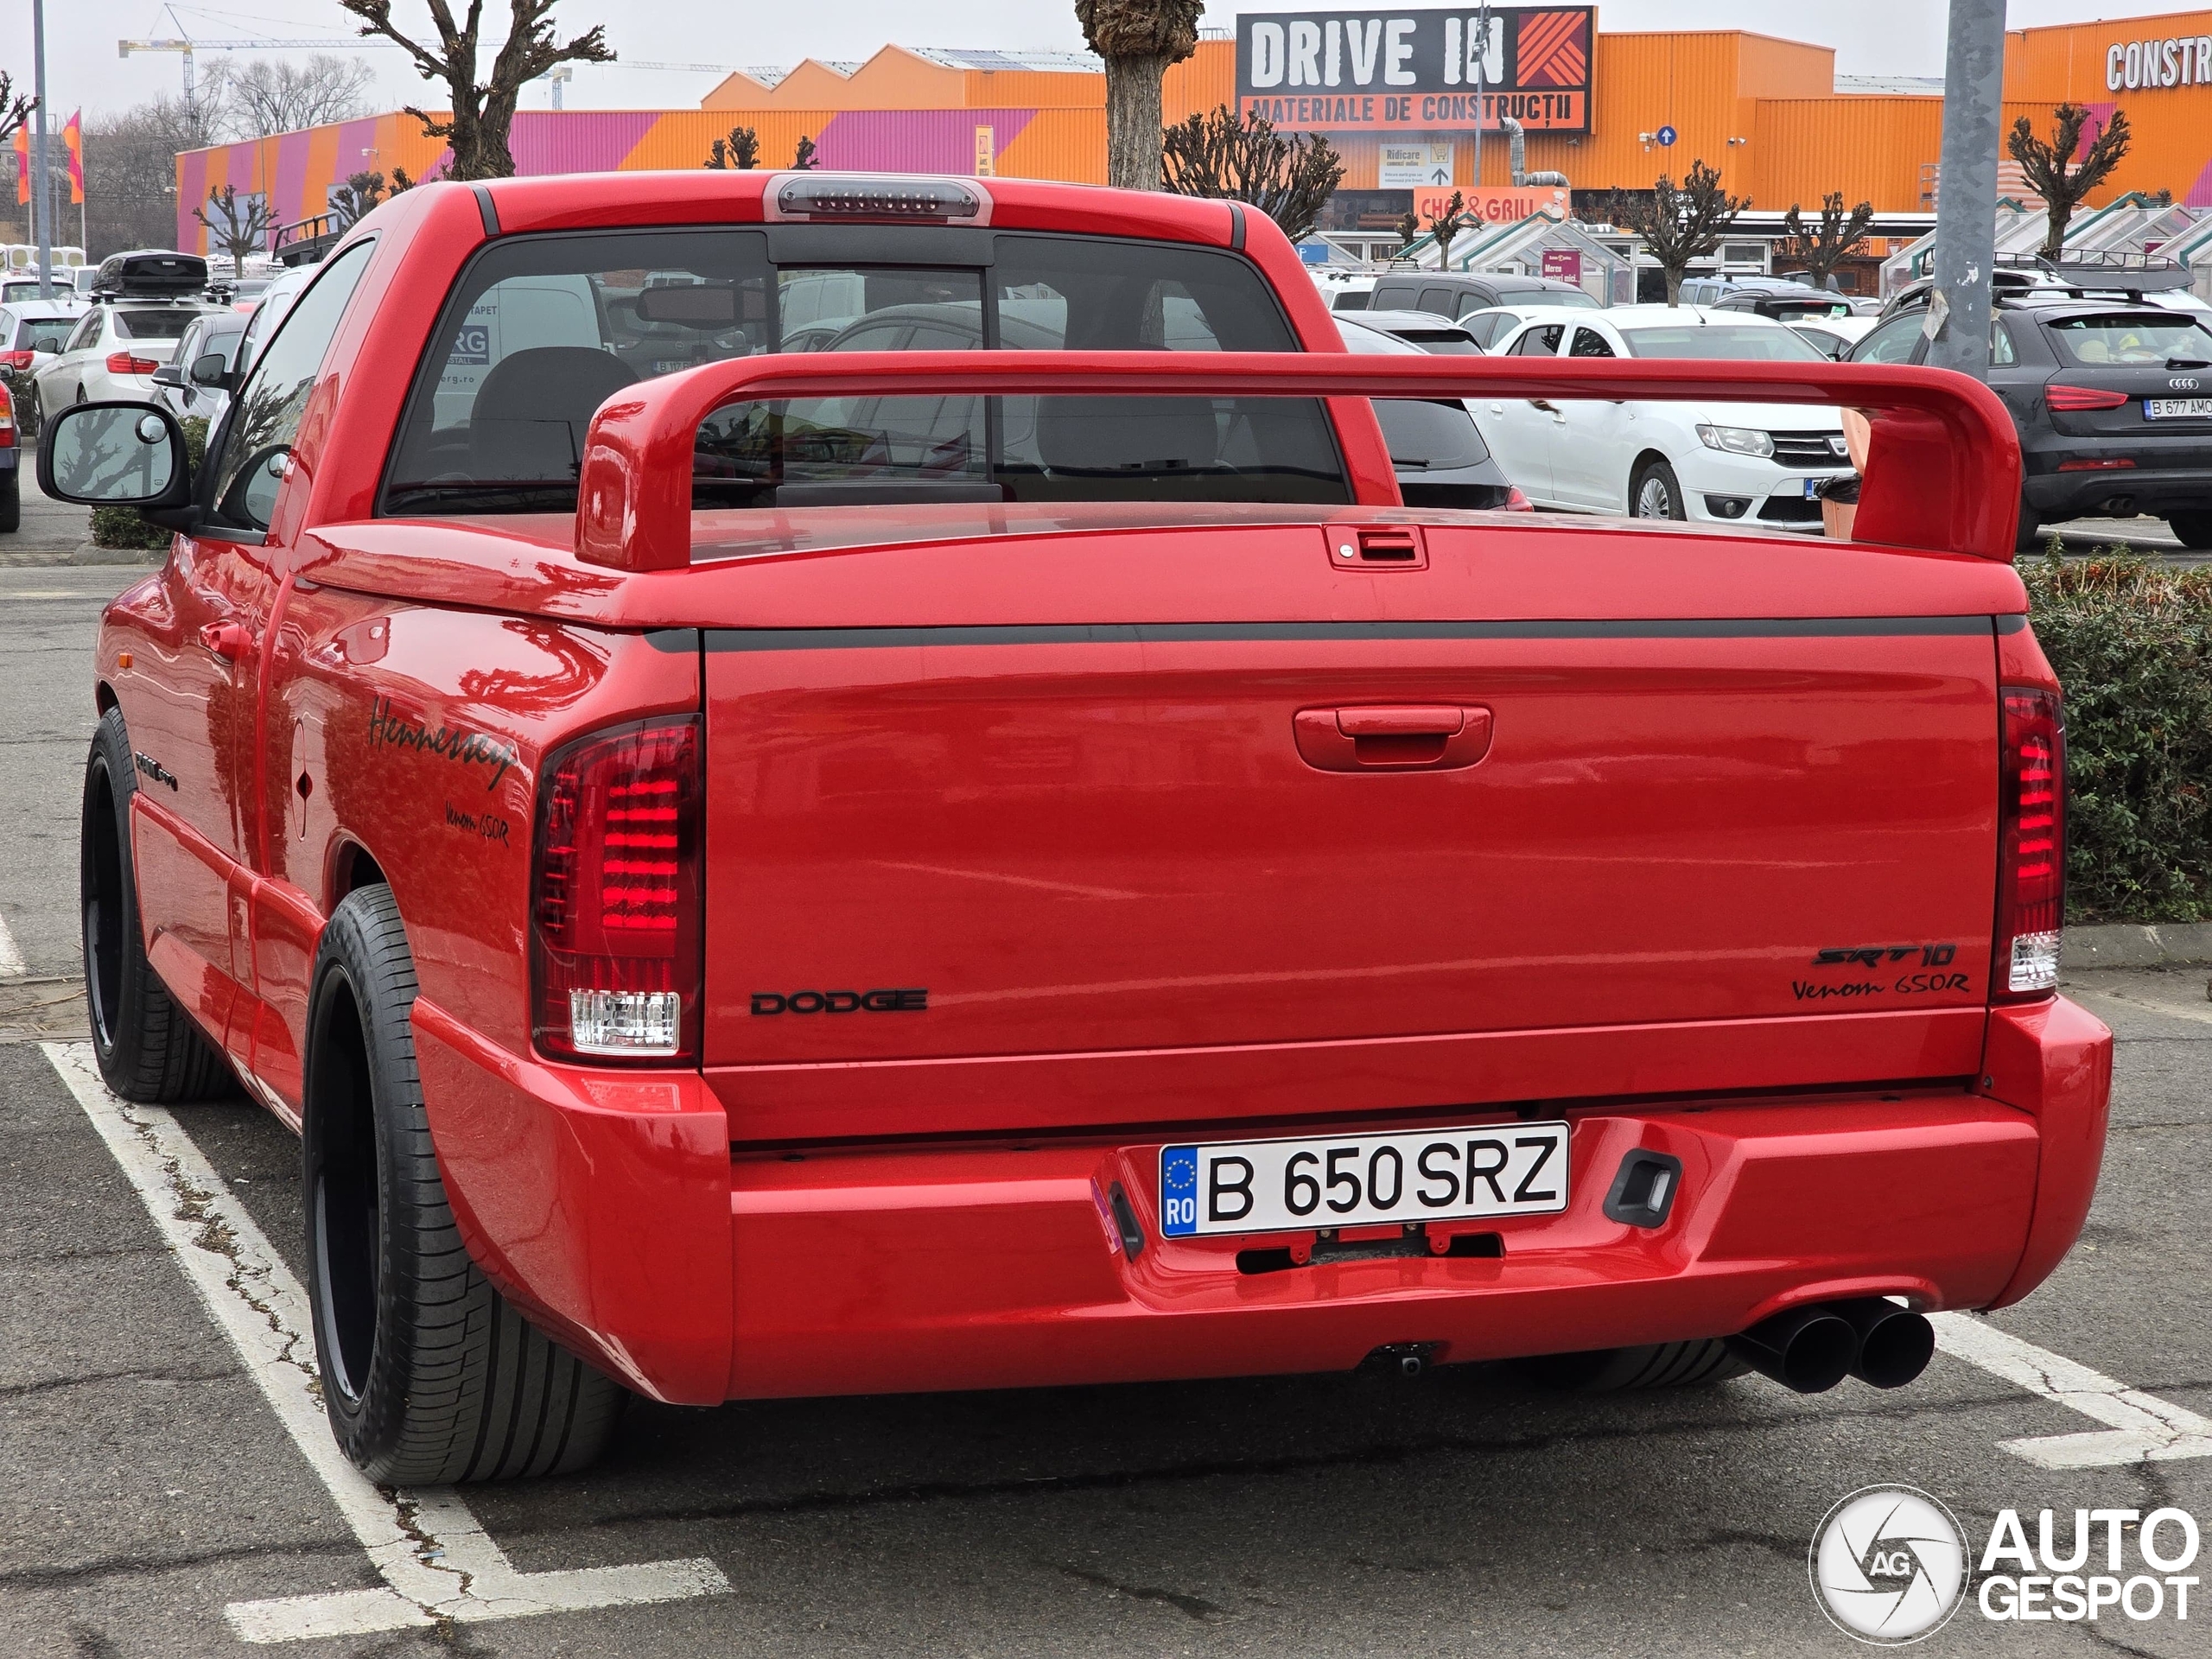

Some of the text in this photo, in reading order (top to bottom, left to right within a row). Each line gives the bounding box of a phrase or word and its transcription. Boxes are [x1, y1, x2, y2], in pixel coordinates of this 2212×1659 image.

[1251, 16, 1504, 87] DRIVE IN
[2107, 35, 2212, 92] CONSTR
[1253, 97, 1375, 123] MATERIALE
[1384, 96, 1411, 122] DE
[1386, 149, 1421, 160] Ridicare
[1467, 195, 1484, 221] &
[1485, 198, 1534, 221] GRILL
[2152, 401, 2161, 415] B
[2165, 400, 2186, 414] 677
[369, 695, 518, 791] Hennessey
[445, 800, 510, 849] Venom 650R
[1791, 973, 1971, 1001] Venom 650R
[750, 988, 928, 1016] DODGE
[1209, 1135, 1559, 1223] B 650 SRZ
[1166, 1198, 1195, 1225] RO
